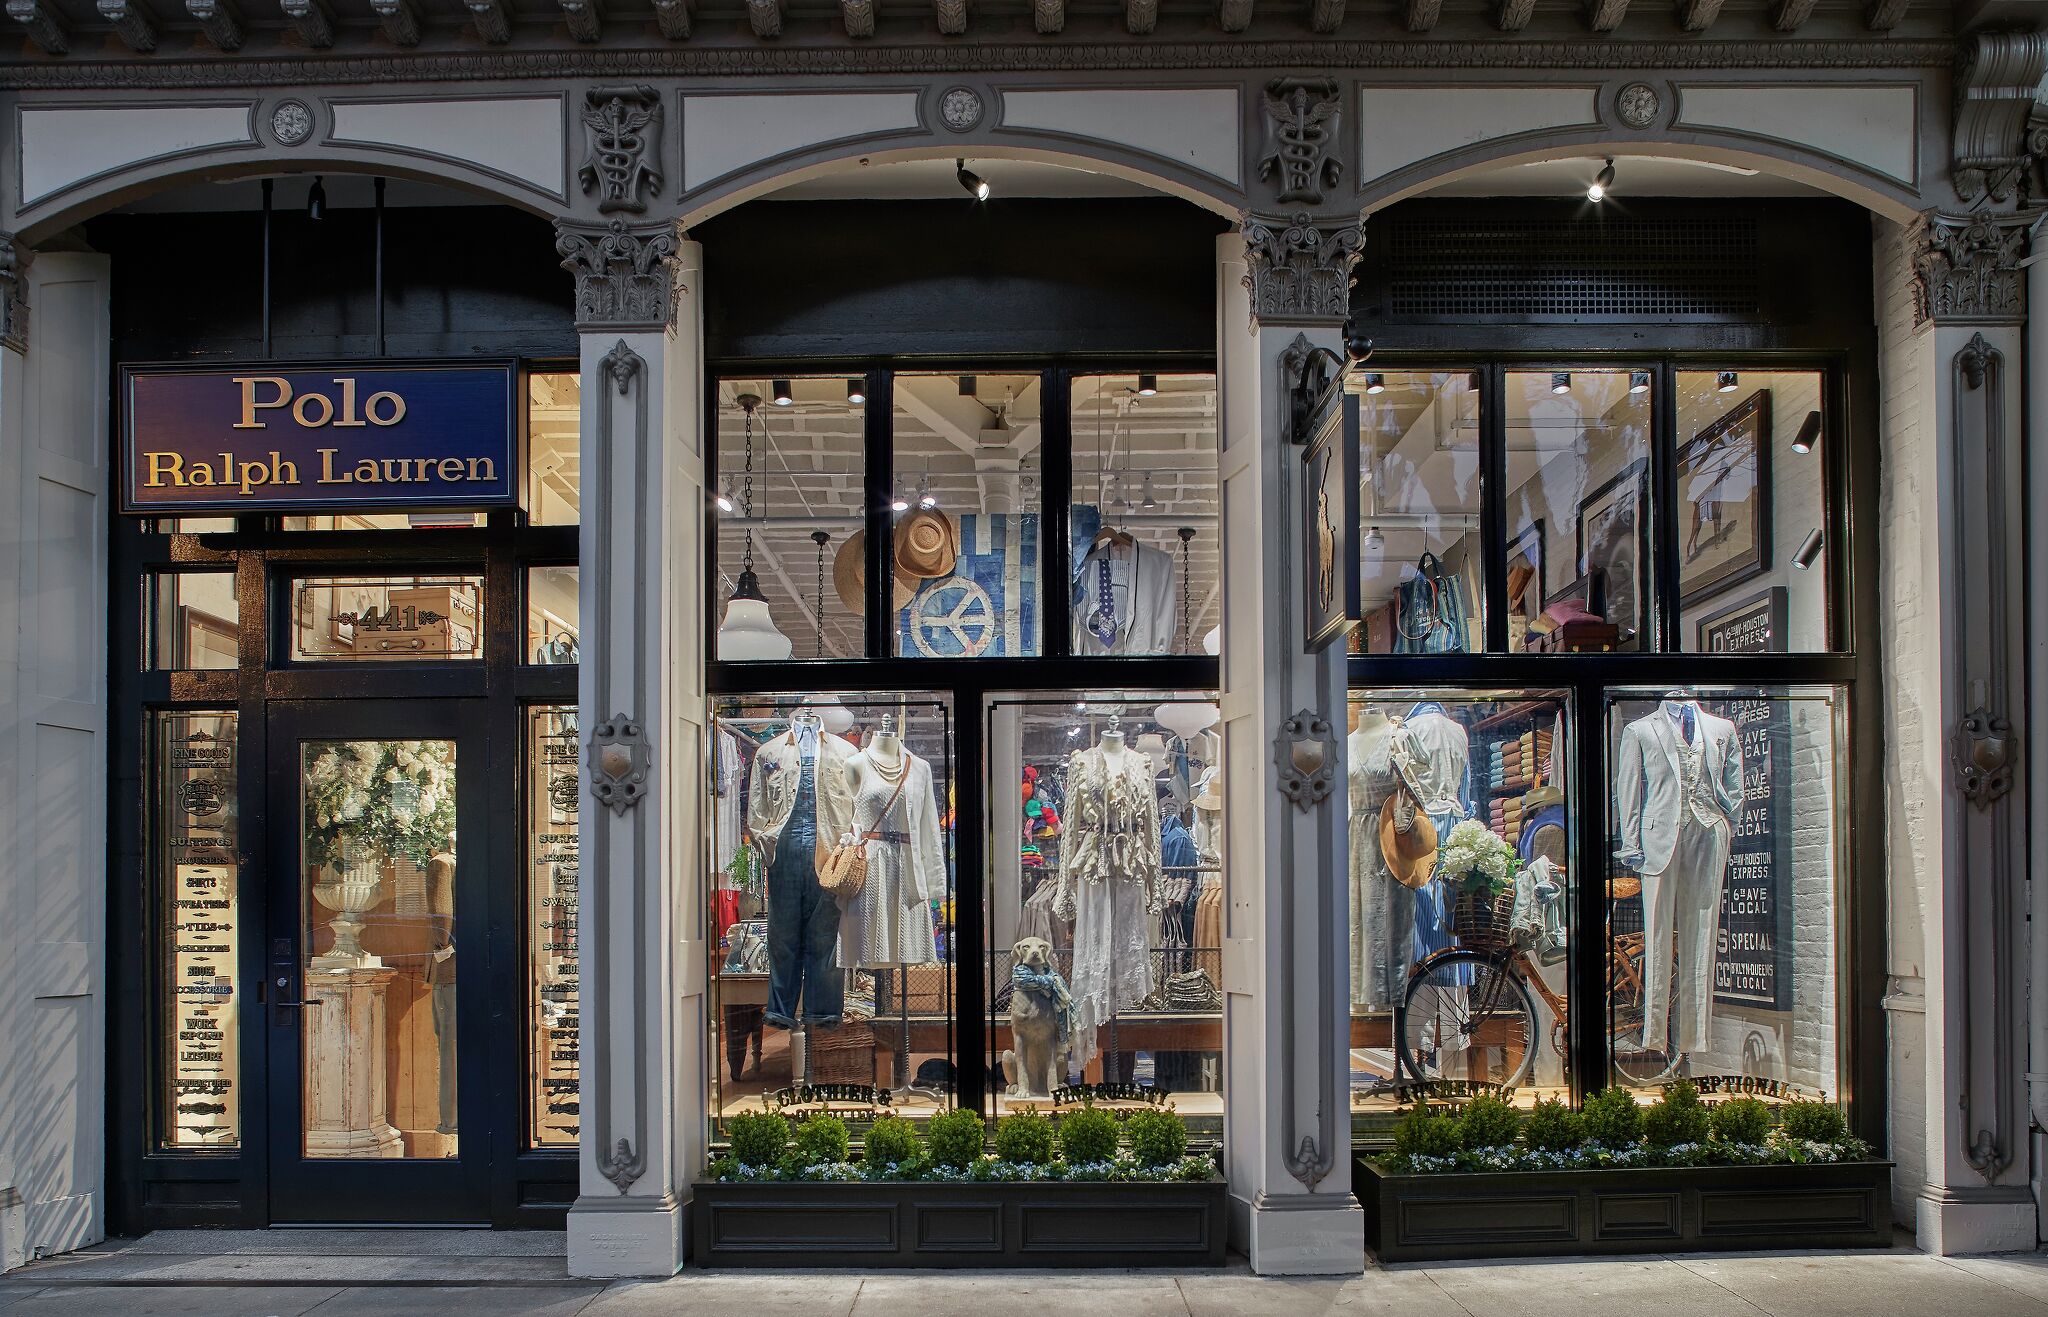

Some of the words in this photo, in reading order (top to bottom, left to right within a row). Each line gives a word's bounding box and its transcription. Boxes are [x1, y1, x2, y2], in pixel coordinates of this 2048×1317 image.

[232, 377, 408, 429] Polo
[143, 451, 301, 496] Ralph
[316, 448, 499, 484] Lauren
[358, 605, 420, 632] 441
[1730, 627, 1766, 651] EXPRESS
[1745, 729, 1767, 745] AVE
[173, 748, 197, 758] FINE
[197, 748, 230, 758] GOODS
[543, 745, 567, 755] FINE
[1744, 743, 1769, 759] CAL
[1744, 772, 1767, 788] AVE
[1744, 786, 1771, 801] RESS
[1745, 808, 1767, 822] AVE
[1737, 823, 1770, 837] OCAL
[169, 837, 232, 847] SUITINGS
[174, 857, 229, 865] TROUSERS
[544, 854, 578, 862] TROUS
[1732, 866, 1769, 880] EXPRESS
[186, 877, 217, 888] SHIRTS
[1747, 888, 1767, 901] AVE
[172, 900, 230, 909] SWEATERS
[1730, 902, 1768, 914] LOCAL
[185, 923, 217, 931] TIES
[1717, 928, 1728, 953] S
[1732, 933, 1772, 951] SPECIAL
[187, 966, 216, 977] SHOES
[1736, 977, 1767, 990] LOCAL
[171, 986, 234, 994] ACCESSORIES
[185, 1019, 218, 1029] WORK
[180, 1031, 223, 1040] SPORT
[180, 1051, 223, 1061] LEISURE
[551, 1051, 579, 1060] LEISU
[172, 1079, 232, 1087] MANUFACTURED
[543, 1079, 579, 1087] MANUFAC
[777, 1083, 874, 1106] CLOTHIER
[877, 1088, 893, 1106] &
[1051, 1085, 1092, 1107] FINE
[1094, 1082, 1172, 1106] QUALITY
[1398, 1080, 1515, 1105] AUTHENTIC
